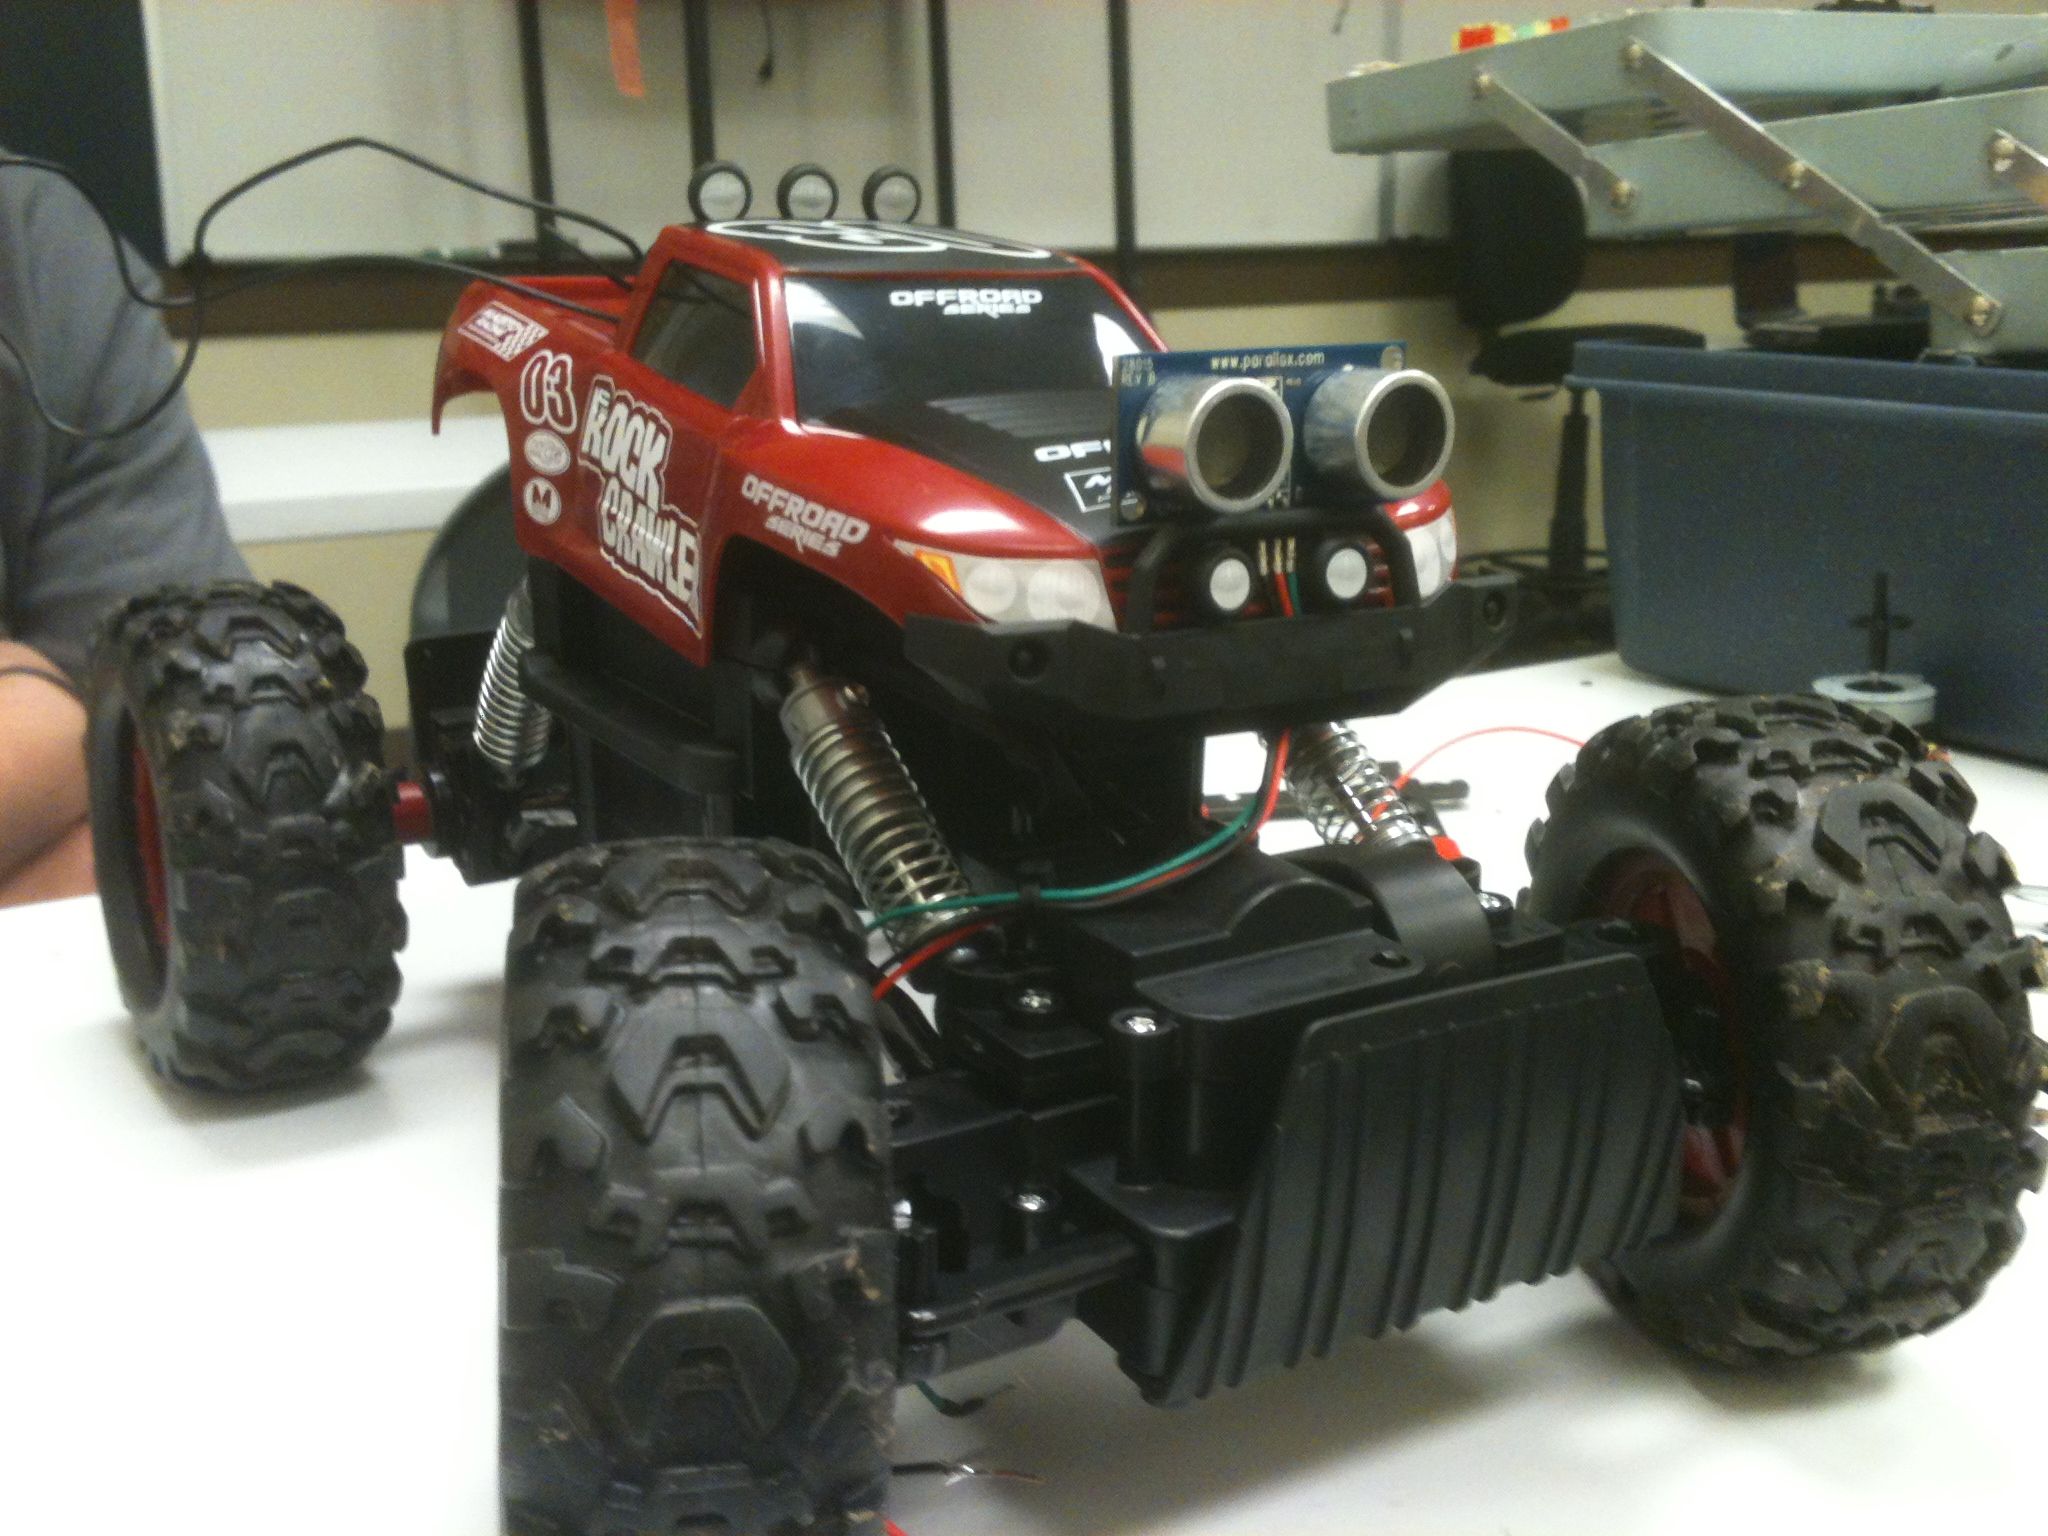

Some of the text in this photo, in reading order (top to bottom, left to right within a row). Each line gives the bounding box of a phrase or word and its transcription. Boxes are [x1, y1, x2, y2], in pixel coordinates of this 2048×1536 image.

[889, 288, 1043, 307] OFFROAD
[581, 387, 667, 514] ROCK
[742, 473, 871, 544] OFFROAD
[764, 515, 843, 557] SERIES
